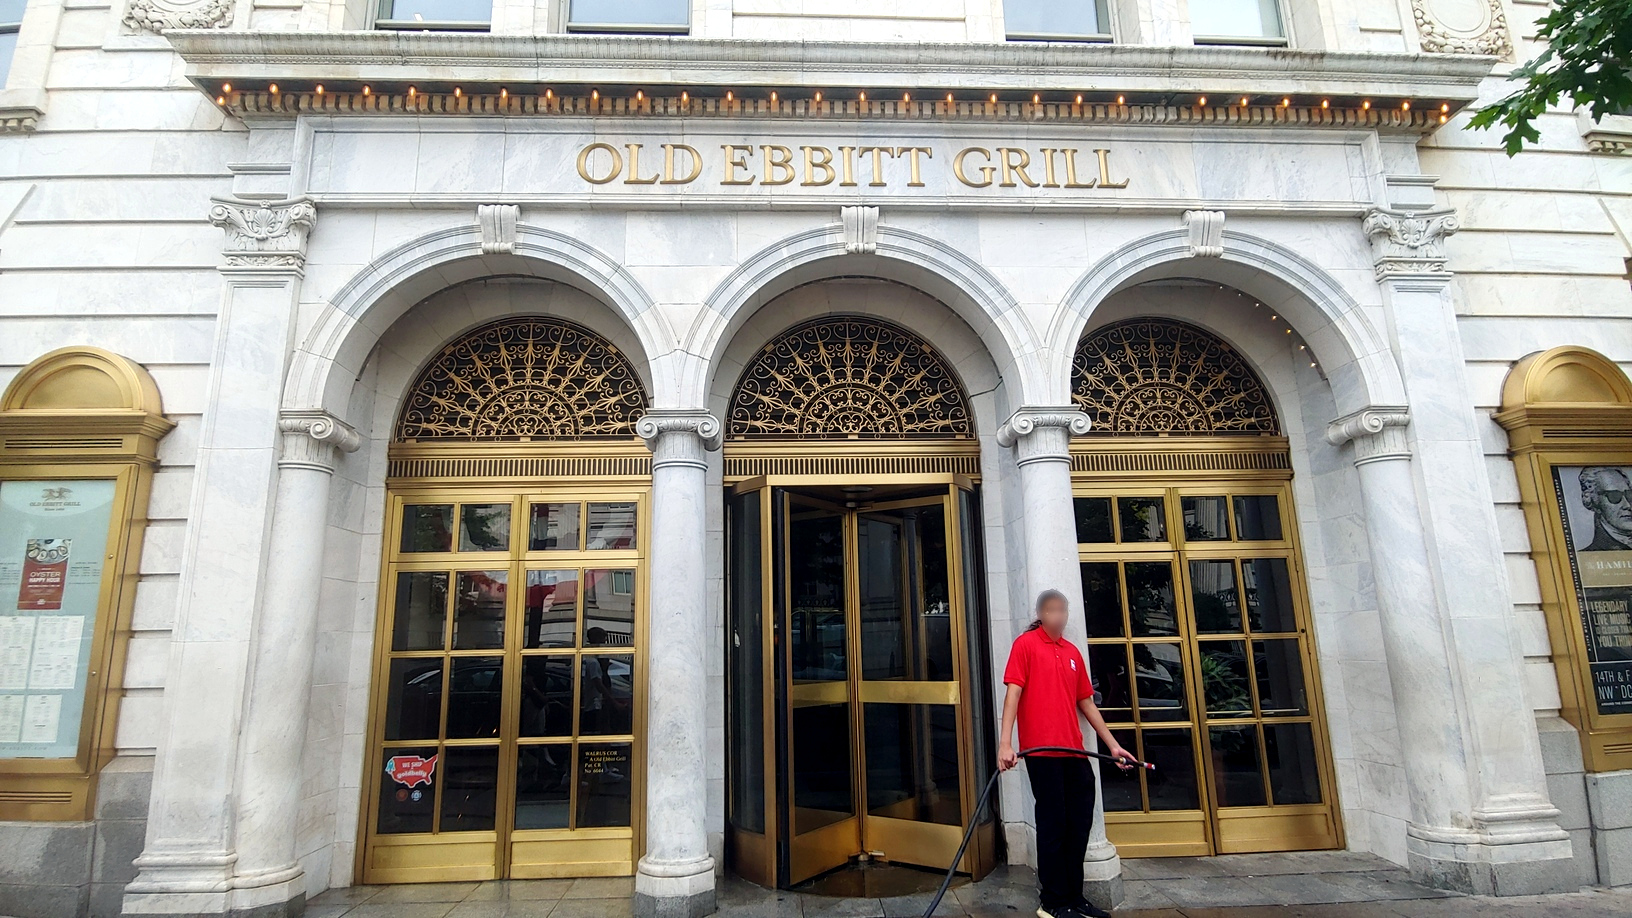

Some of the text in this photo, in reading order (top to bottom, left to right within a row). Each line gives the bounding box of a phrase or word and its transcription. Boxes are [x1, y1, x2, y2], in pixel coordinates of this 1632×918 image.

[576, 143, 1130, 189] OLD EBBITT GRILL
[1590, 601, 1628, 612] LEGENDARY
[1593, 614, 1630, 625] LIVE MUSIC
[1597, 636, 1612, 648] YOU
[1596, 670, 1630, 682] 14TH & F
[1598, 684, 1632, 700] NW DC
[397, 770, 427, 778] goldbelly
